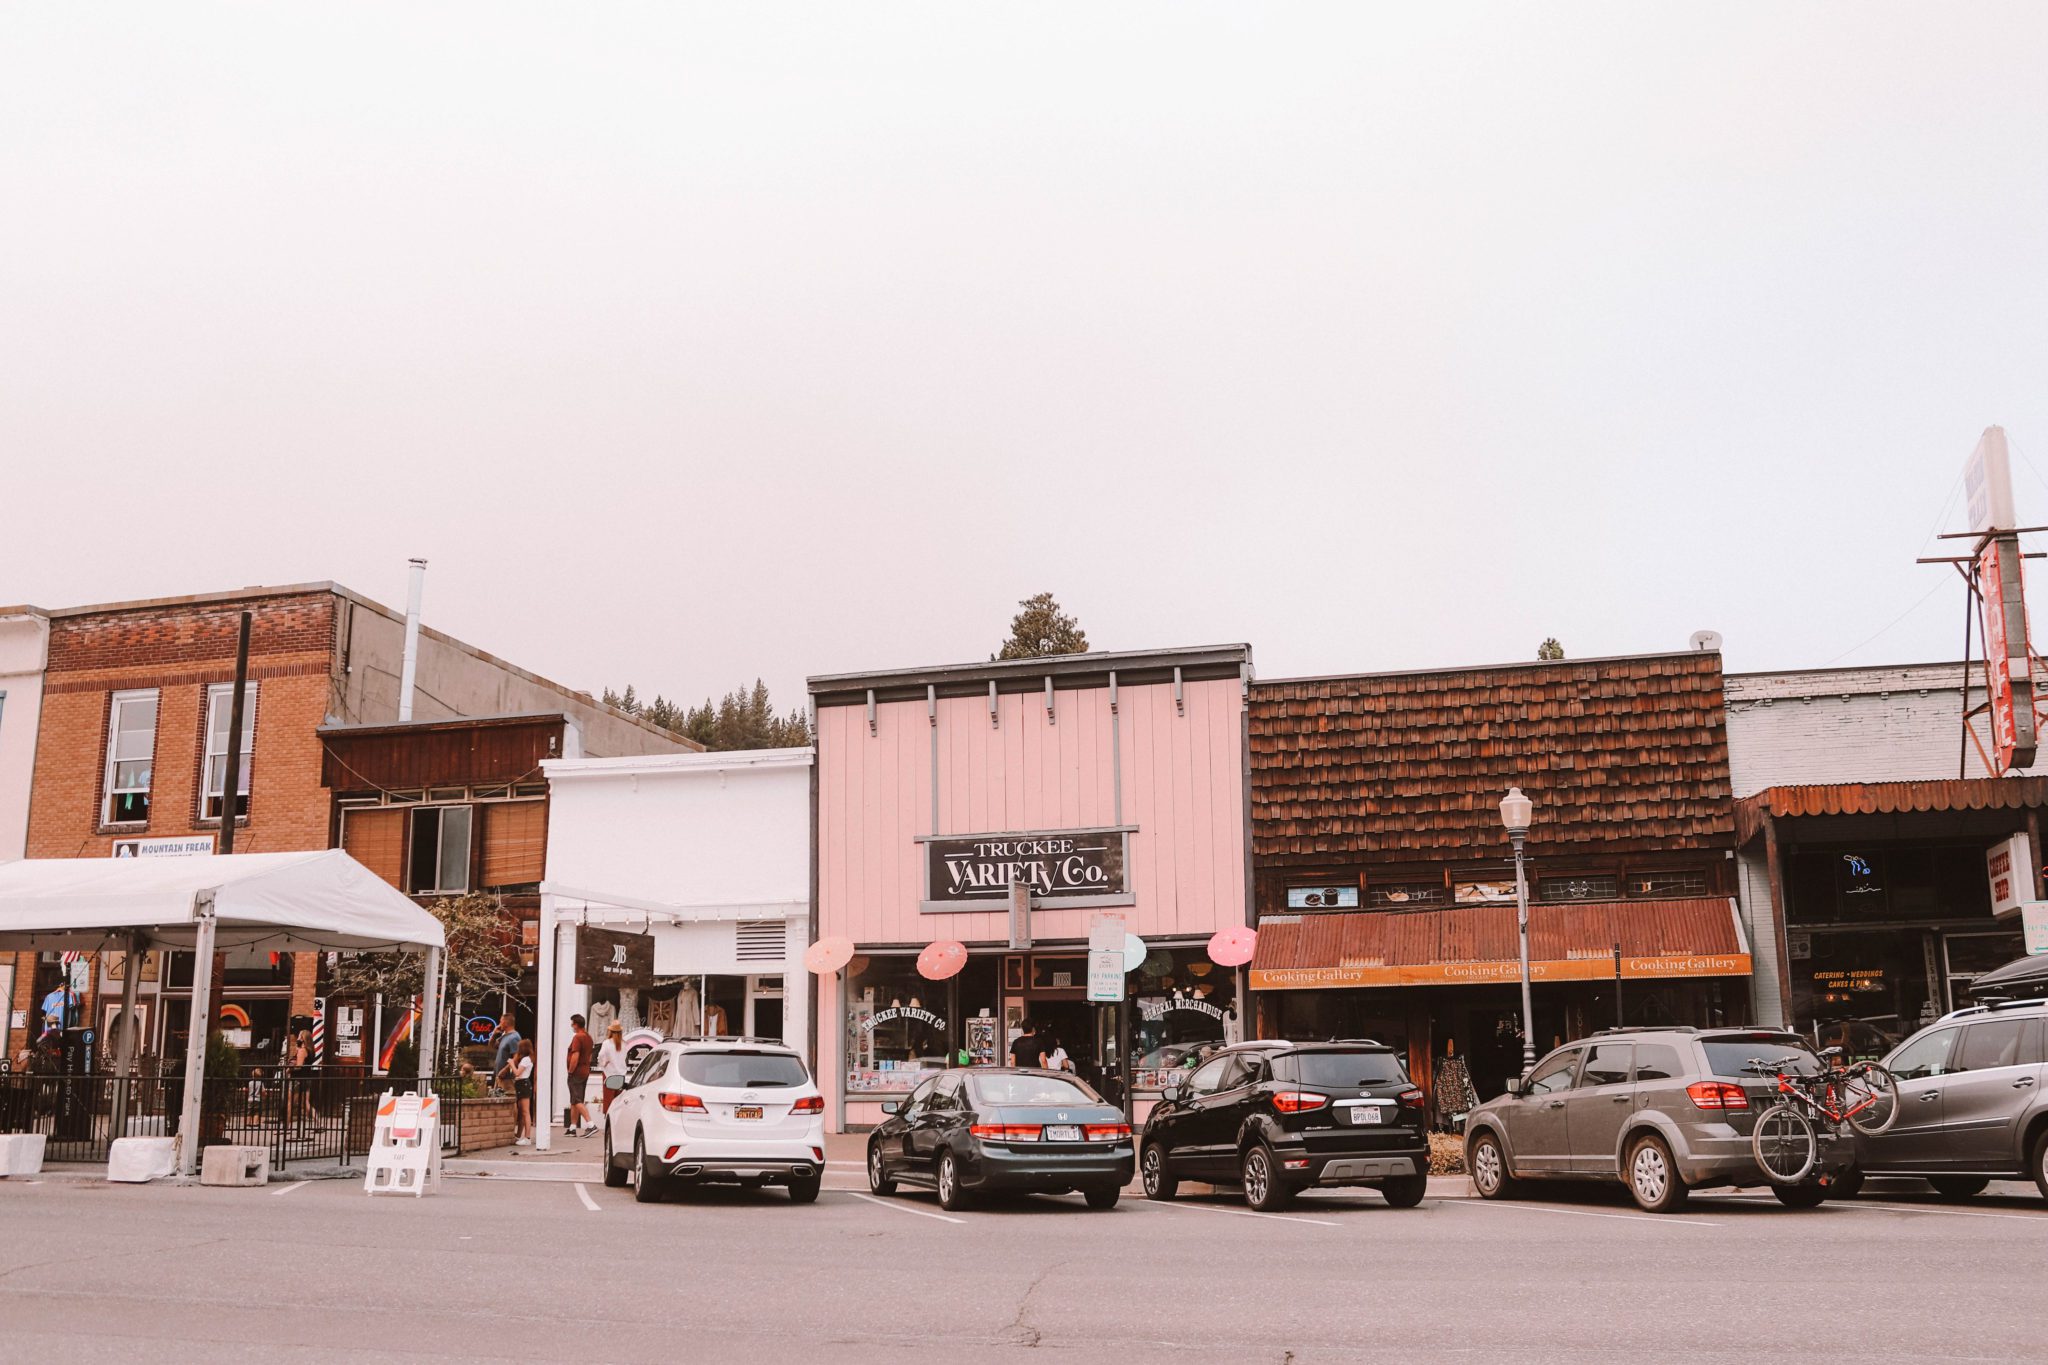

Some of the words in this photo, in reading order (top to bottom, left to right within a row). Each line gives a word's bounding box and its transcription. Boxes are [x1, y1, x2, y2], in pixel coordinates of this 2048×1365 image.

[141, 844, 183, 854] MOUNTAIN
[185, 842, 212, 852] FREAK
[974, 839, 1074, 858] TRUCKEE
[1062, 855, 1109, 886] Co.
[1989, 851, 2010, 879] COFFEE
[1994, 878, 2010, 903] SHOP
[1444, 965, 1498, 977] Cooking
[1630, 959, 1686, 970] Cooking
[1687, 957, 1736, 970] Gallery
[1263, 970, 1316, 983] Cooking
[1316, 968, 1363, 981] Gallery
[1814, 971, 1845, 980] CATERING
[1851, 969, 1883, 978] WEDDINGS
[1828, 980, 1848, 988] CAKES
[1143, 1000, 1174, 1021] GENERAL
[1175, 999, 1223, 1020] MERCHANDISE
[861, 1008, 898, 1031] TRUCKEE
[899, 1007, 937, 1025] VARIETY
[66, 1046, 75, 1062] Pay
